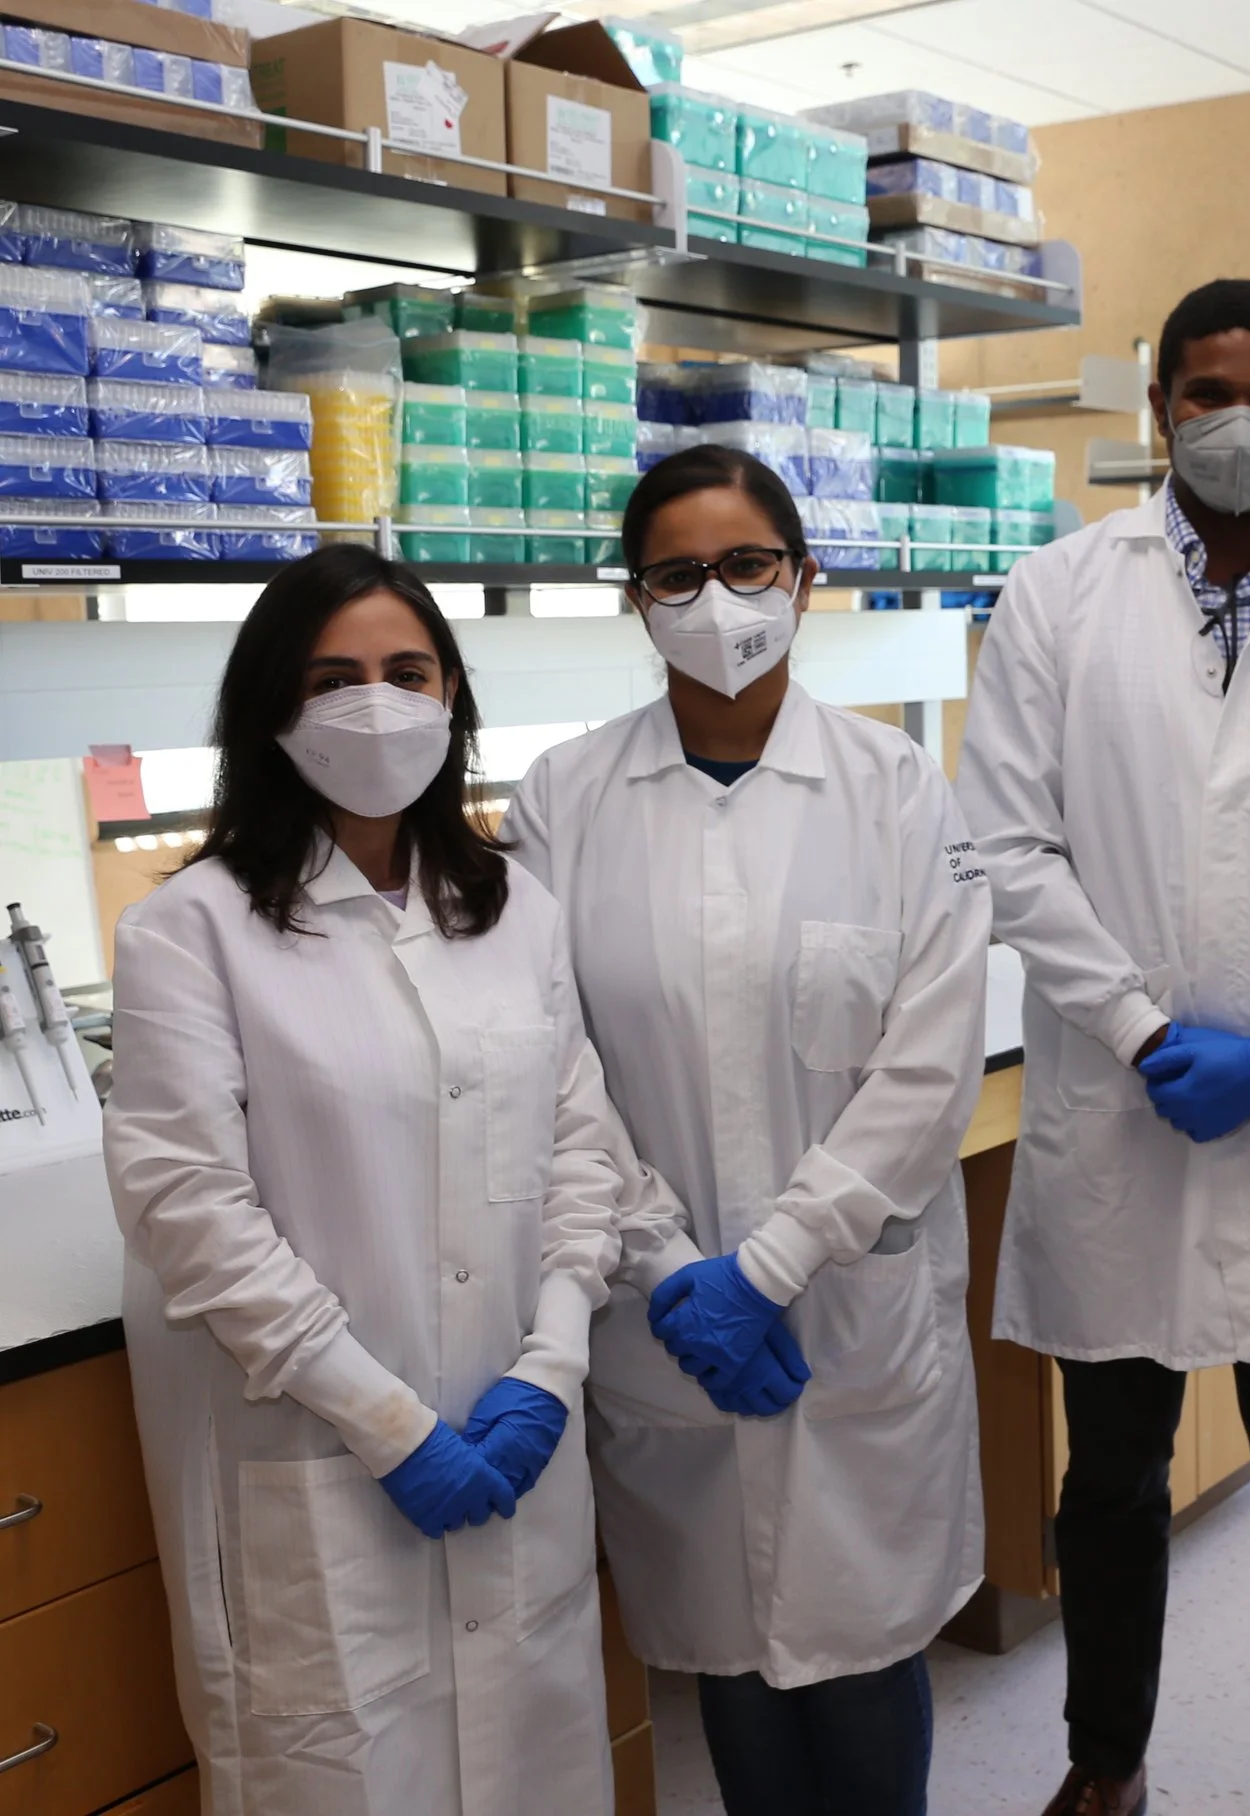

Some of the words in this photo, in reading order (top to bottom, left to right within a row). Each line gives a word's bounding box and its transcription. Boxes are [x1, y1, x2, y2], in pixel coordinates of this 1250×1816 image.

[32, 567, 53, 576] UNIV
[55, 568, 69, 576] 200
[70, 568, 111, 576] FILTERED
